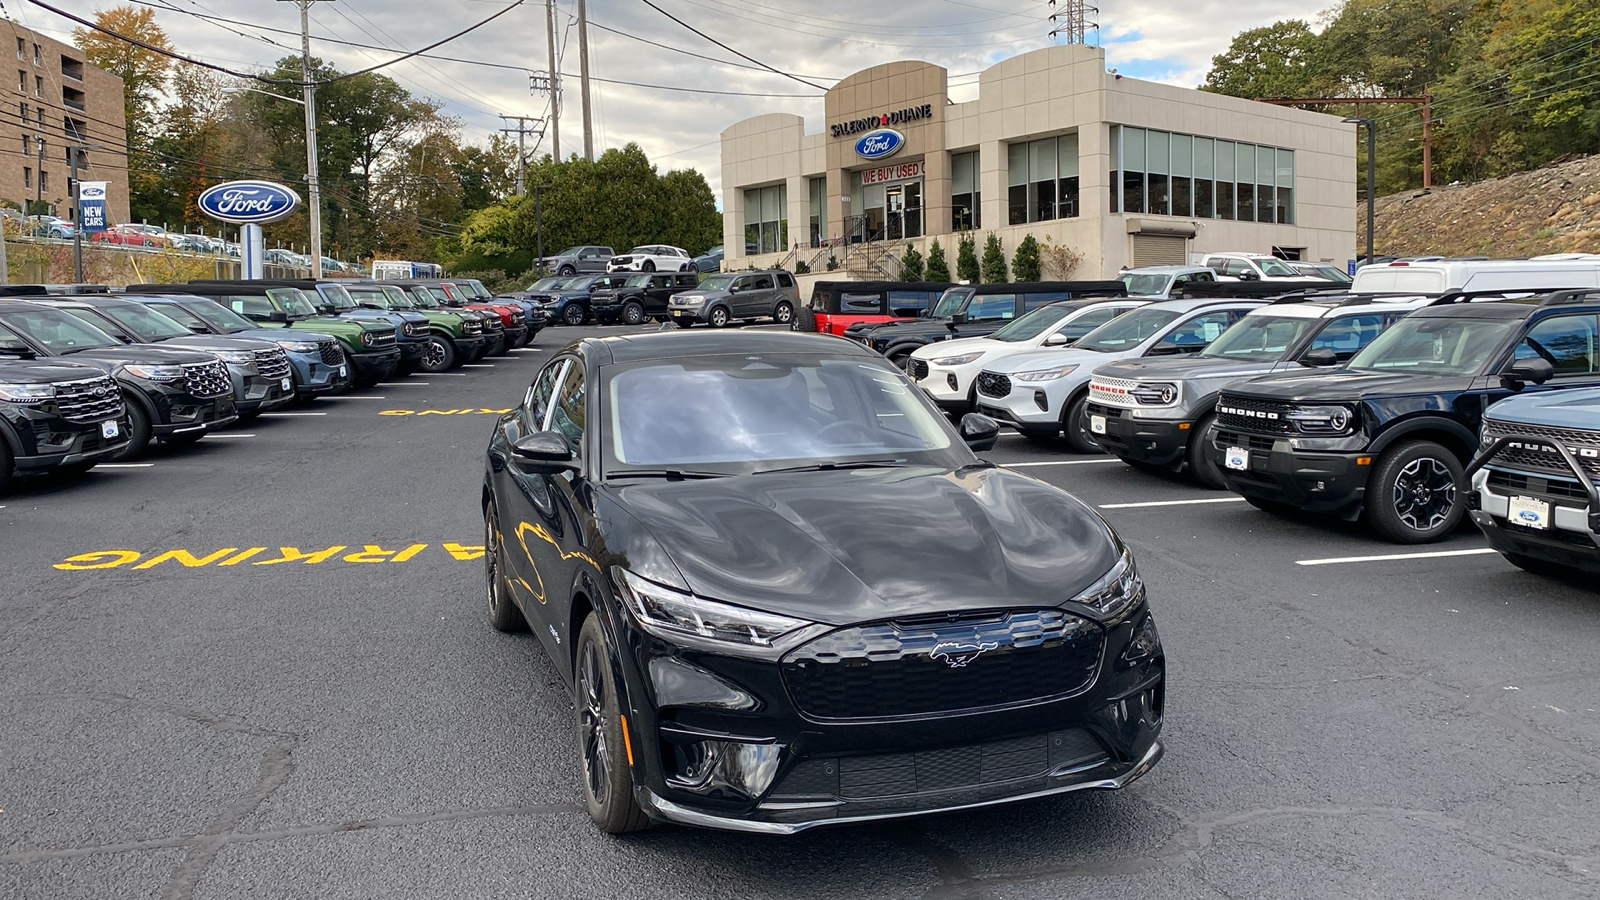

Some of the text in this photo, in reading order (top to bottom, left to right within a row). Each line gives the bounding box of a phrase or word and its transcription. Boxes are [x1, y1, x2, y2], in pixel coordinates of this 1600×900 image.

[830, 104, 932, 137] SALERNO DUANE
[863, 135, 890, 153] Ford
[863, 172, 876, 183] WE
[878, 166, 895, 182] BUY
[896, 162, 919, 178] USED
[217, 189, 274, 213] Ford
[83, 206, 102, 217] NEW
[84, 217, 104, 227] CARS
[1091, 384, 1125, 394] BRONCO
[378, 407, 514, 416] KING
[1221, 406, 1278, 419] BRONCO
[53, 542, 486, 570] ARKING
